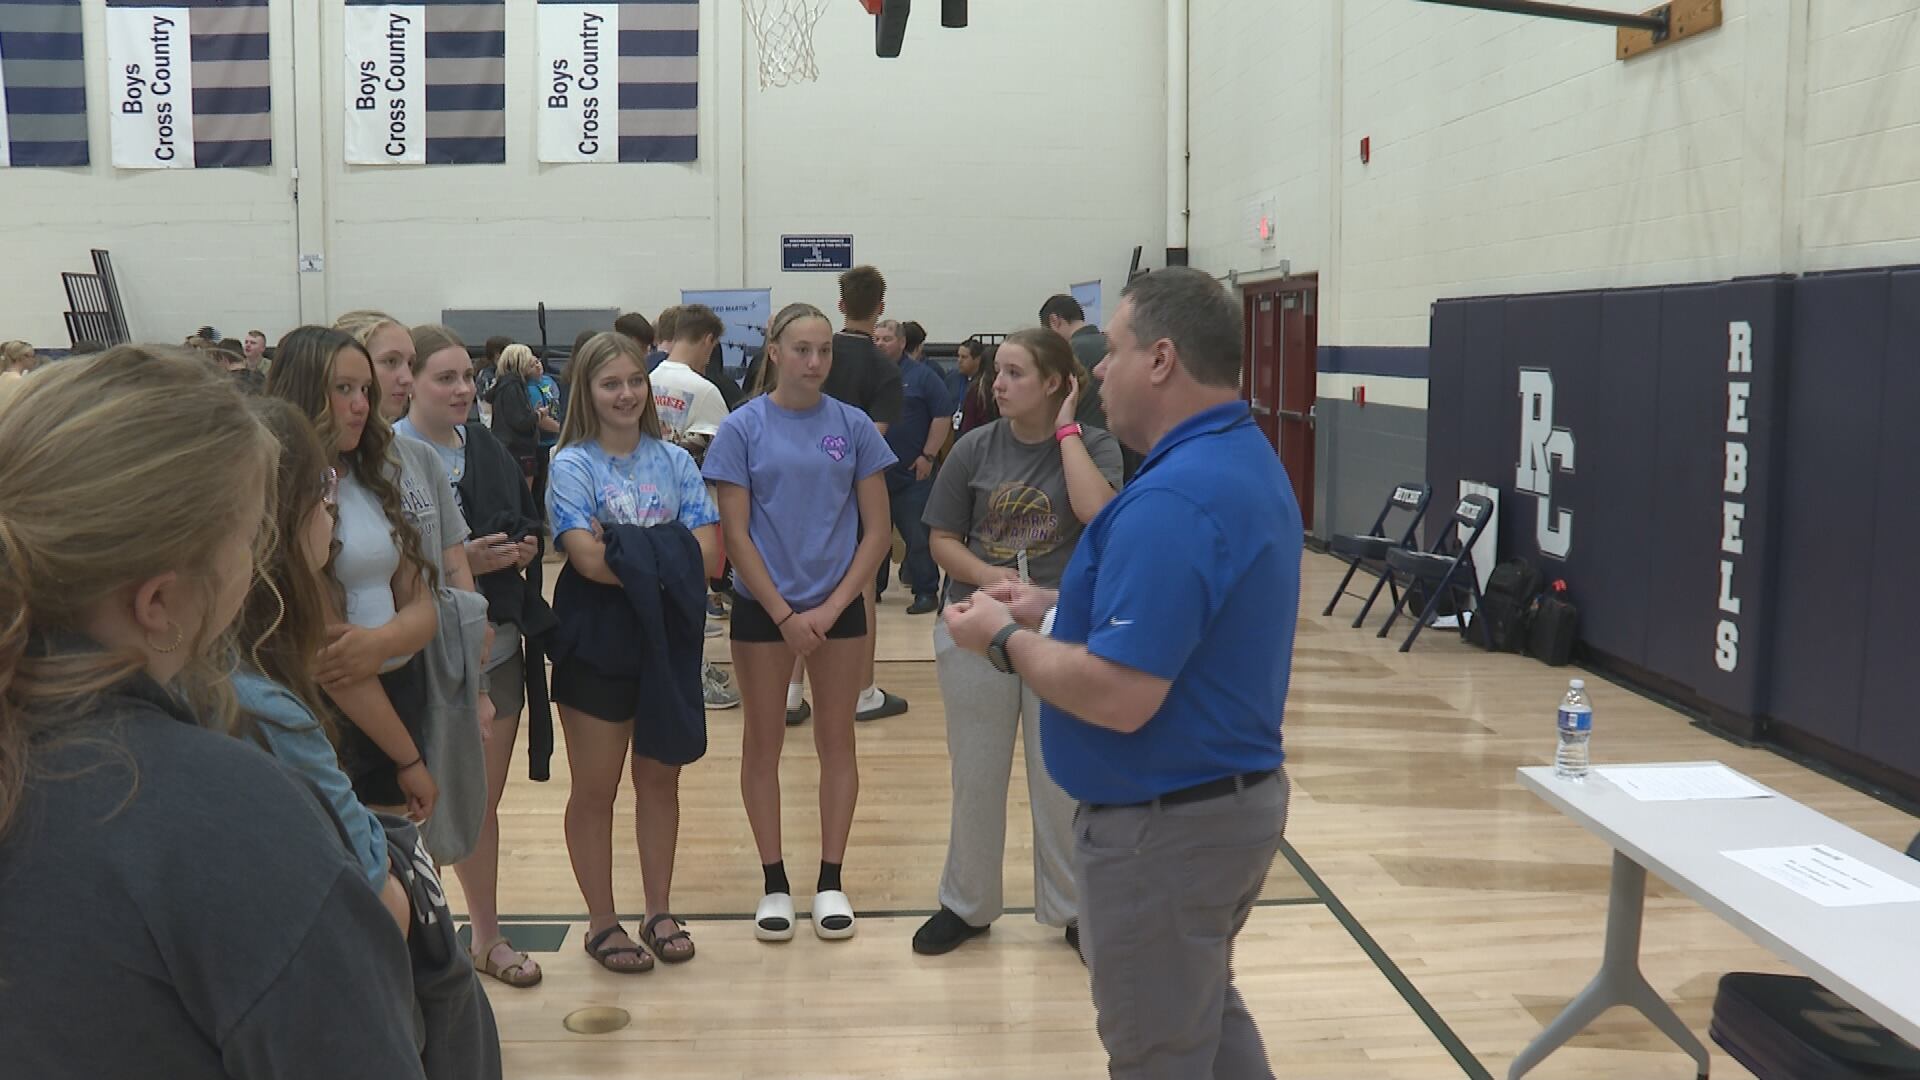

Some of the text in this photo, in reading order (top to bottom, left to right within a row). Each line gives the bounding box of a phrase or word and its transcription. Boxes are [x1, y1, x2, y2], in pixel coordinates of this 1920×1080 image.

[122, 63, 146, 114] Boys
[150, 15, 175, 161] Cross Country
[355, 61, 381, 110] Boys
[385, 13, 411, 157] Cross Country
[547, 59, 574, 109] Boys
[578, 12, 604, 155] Cross Country
[1514, 366, 1576, 561] RC
[1714, 320, 1753, 672] REBELS
